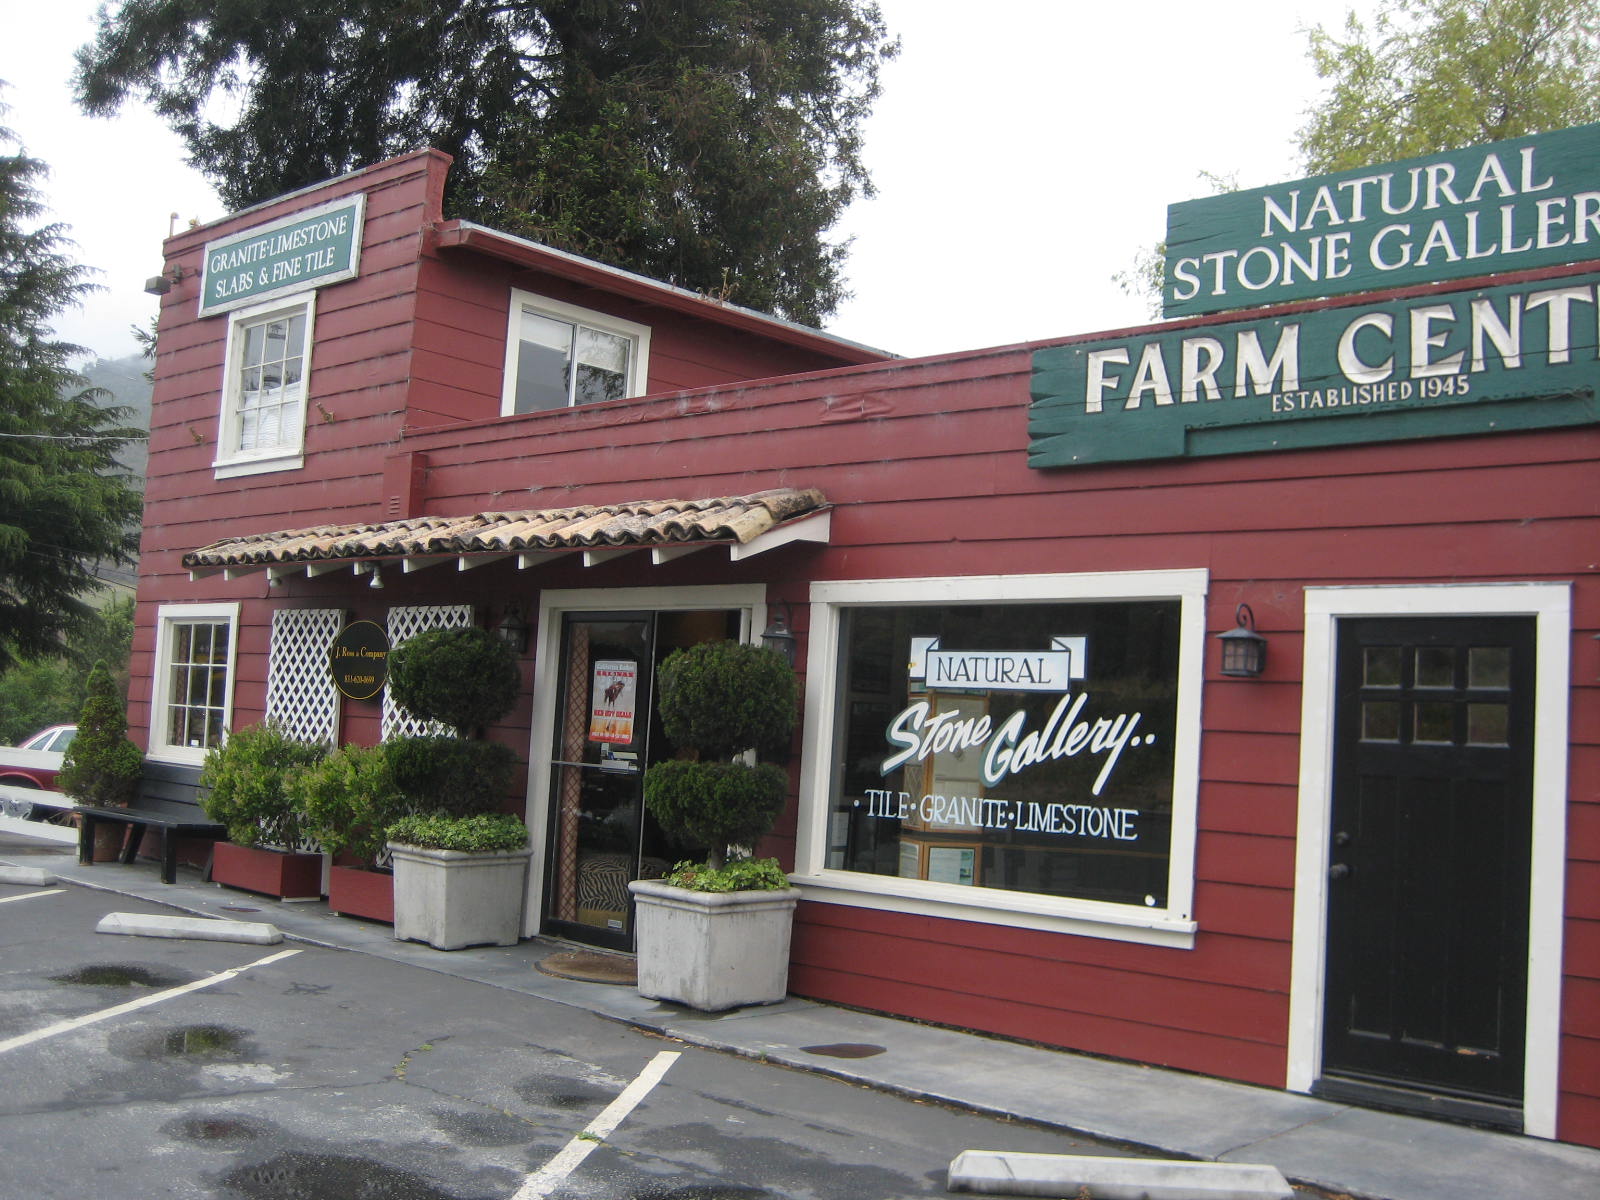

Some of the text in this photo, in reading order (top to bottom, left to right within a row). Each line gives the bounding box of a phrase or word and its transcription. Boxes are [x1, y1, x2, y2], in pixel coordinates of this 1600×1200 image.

[1261, 146, 1553, 238] NATURAL
[215, 246, 336, 299] SLABS & FINE TILE
[1173, 231, 1353, 300] STONE
[1085, 284, 1600, 414] FARM CENT
[1271, 375, 1470, 413] ESTABLISHED 1945
[360, 646, 387, 660] Company
[936, 656, 1052, 684] NATURAL
